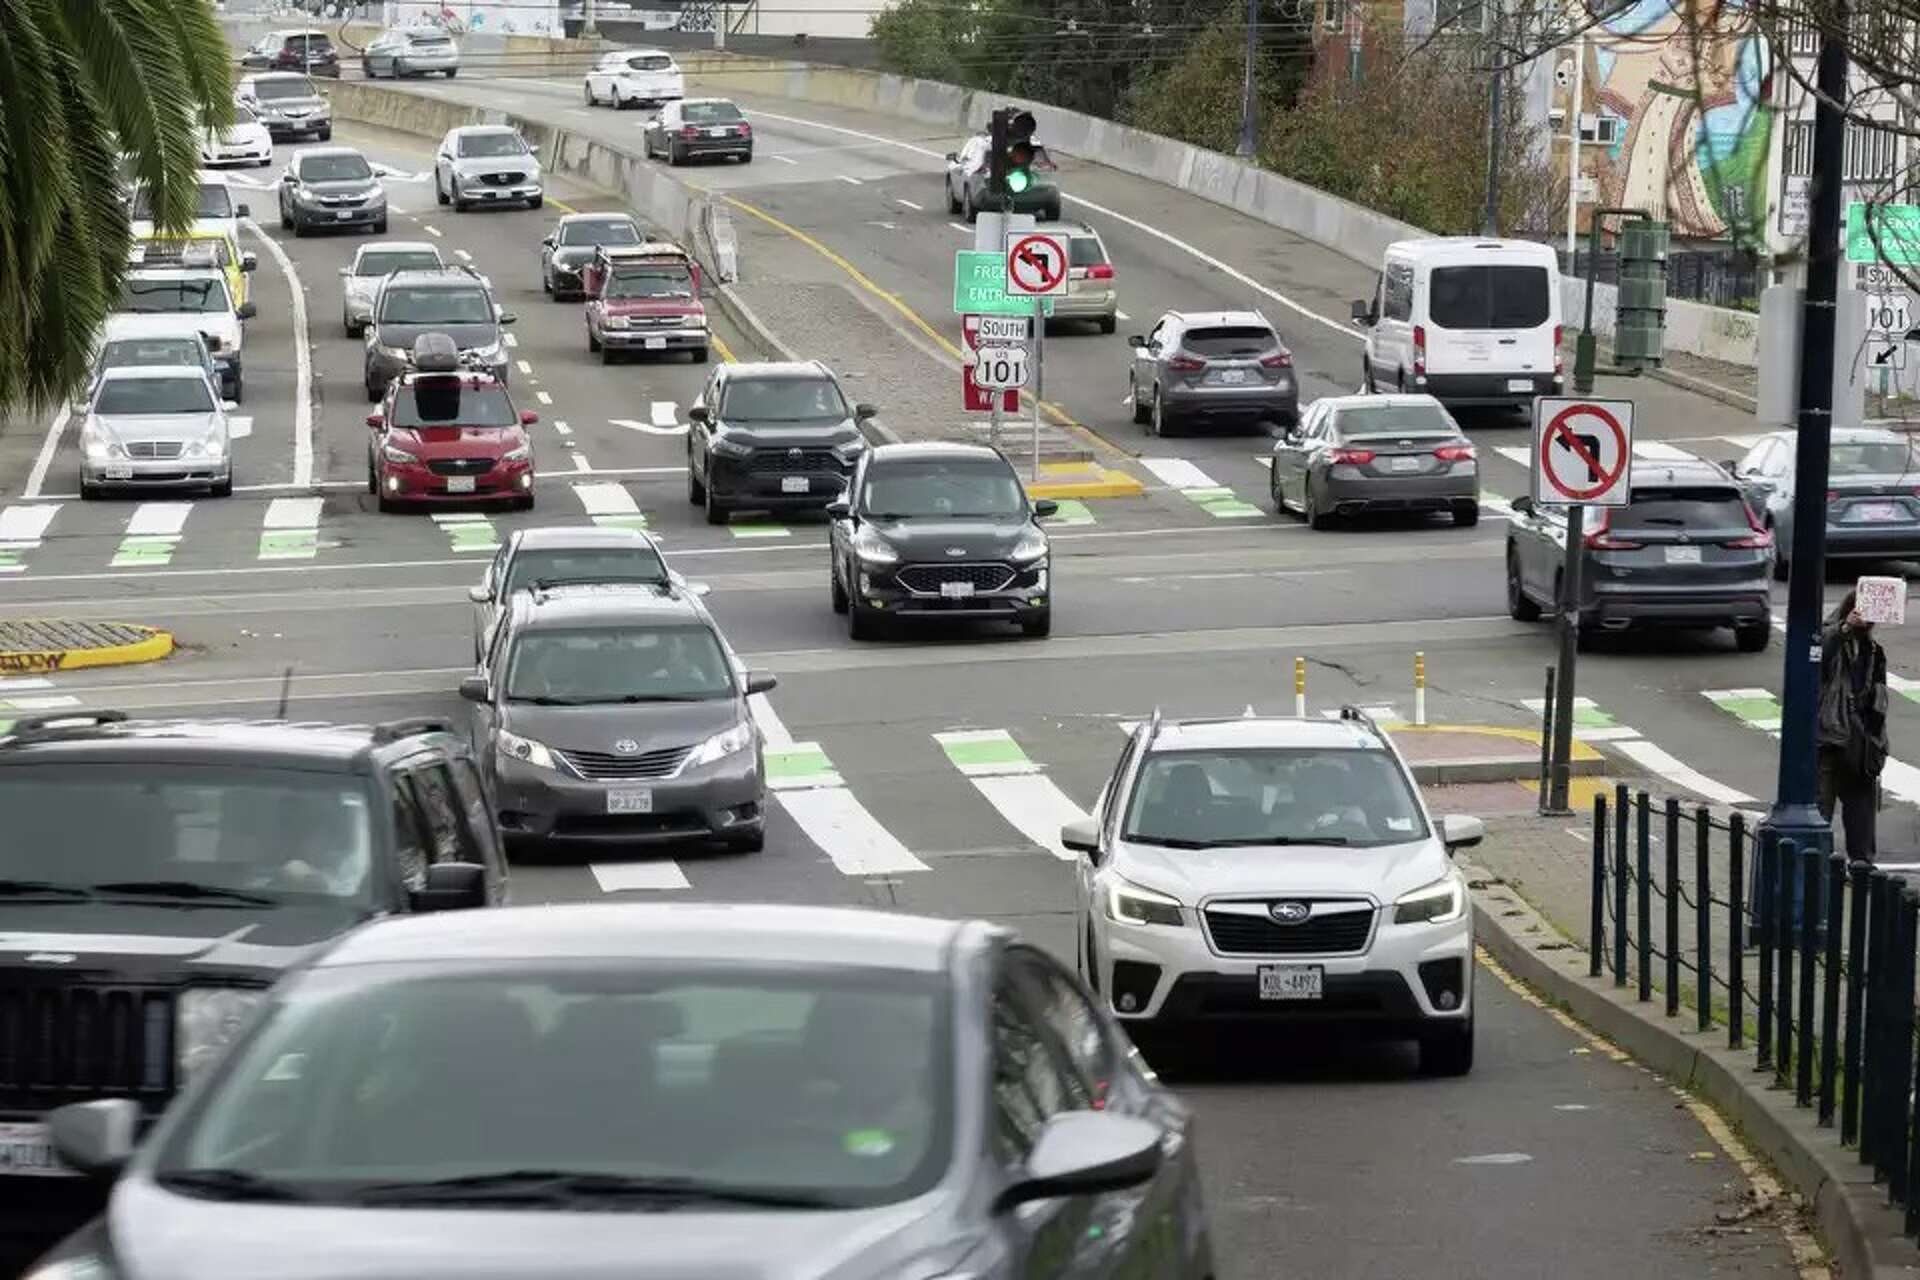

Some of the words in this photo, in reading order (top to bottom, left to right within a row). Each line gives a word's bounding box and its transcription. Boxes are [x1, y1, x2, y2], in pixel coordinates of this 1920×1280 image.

[982, 319, 1025, 337] SOUTH
[1870, 307, 1903, 329] 101
[995, 350, 1009, 360] US
[983, 360, 1020, 384] 101
